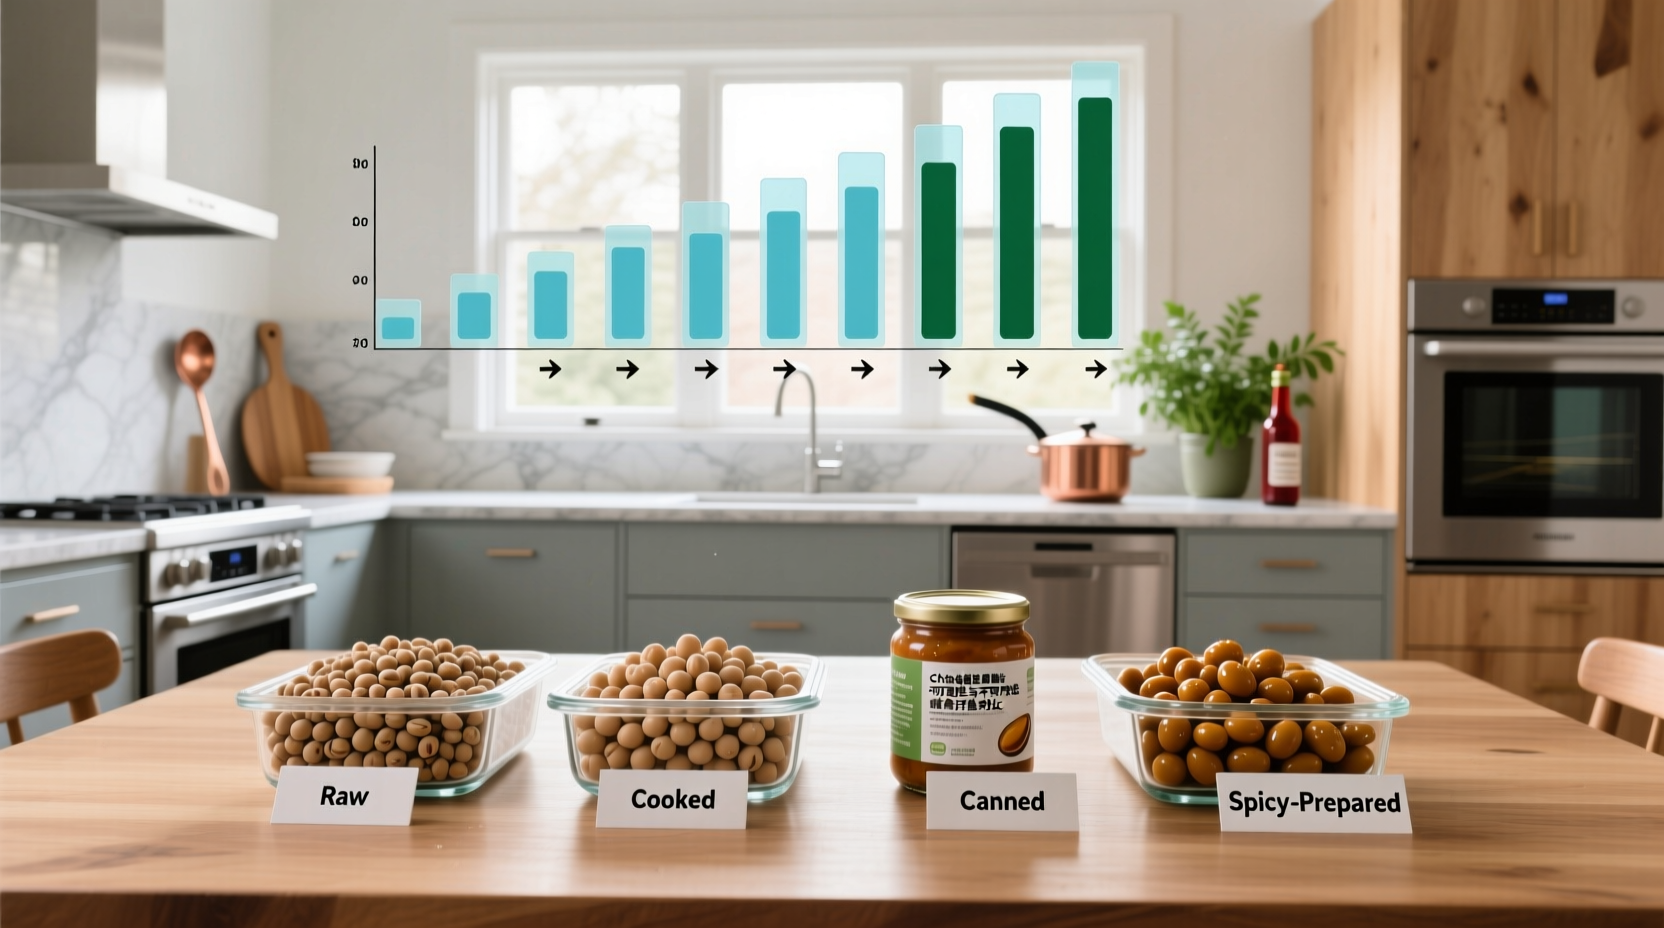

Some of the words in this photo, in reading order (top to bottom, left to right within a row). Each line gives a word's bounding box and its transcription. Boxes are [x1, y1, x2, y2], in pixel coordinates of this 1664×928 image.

[320, 785, 370, 806] Raw
[631, 788, 716, 810] Cooked
[960, 790, 1045, 812] Canned
[1228, 790, 1401, 818] Spicy-Prepared
